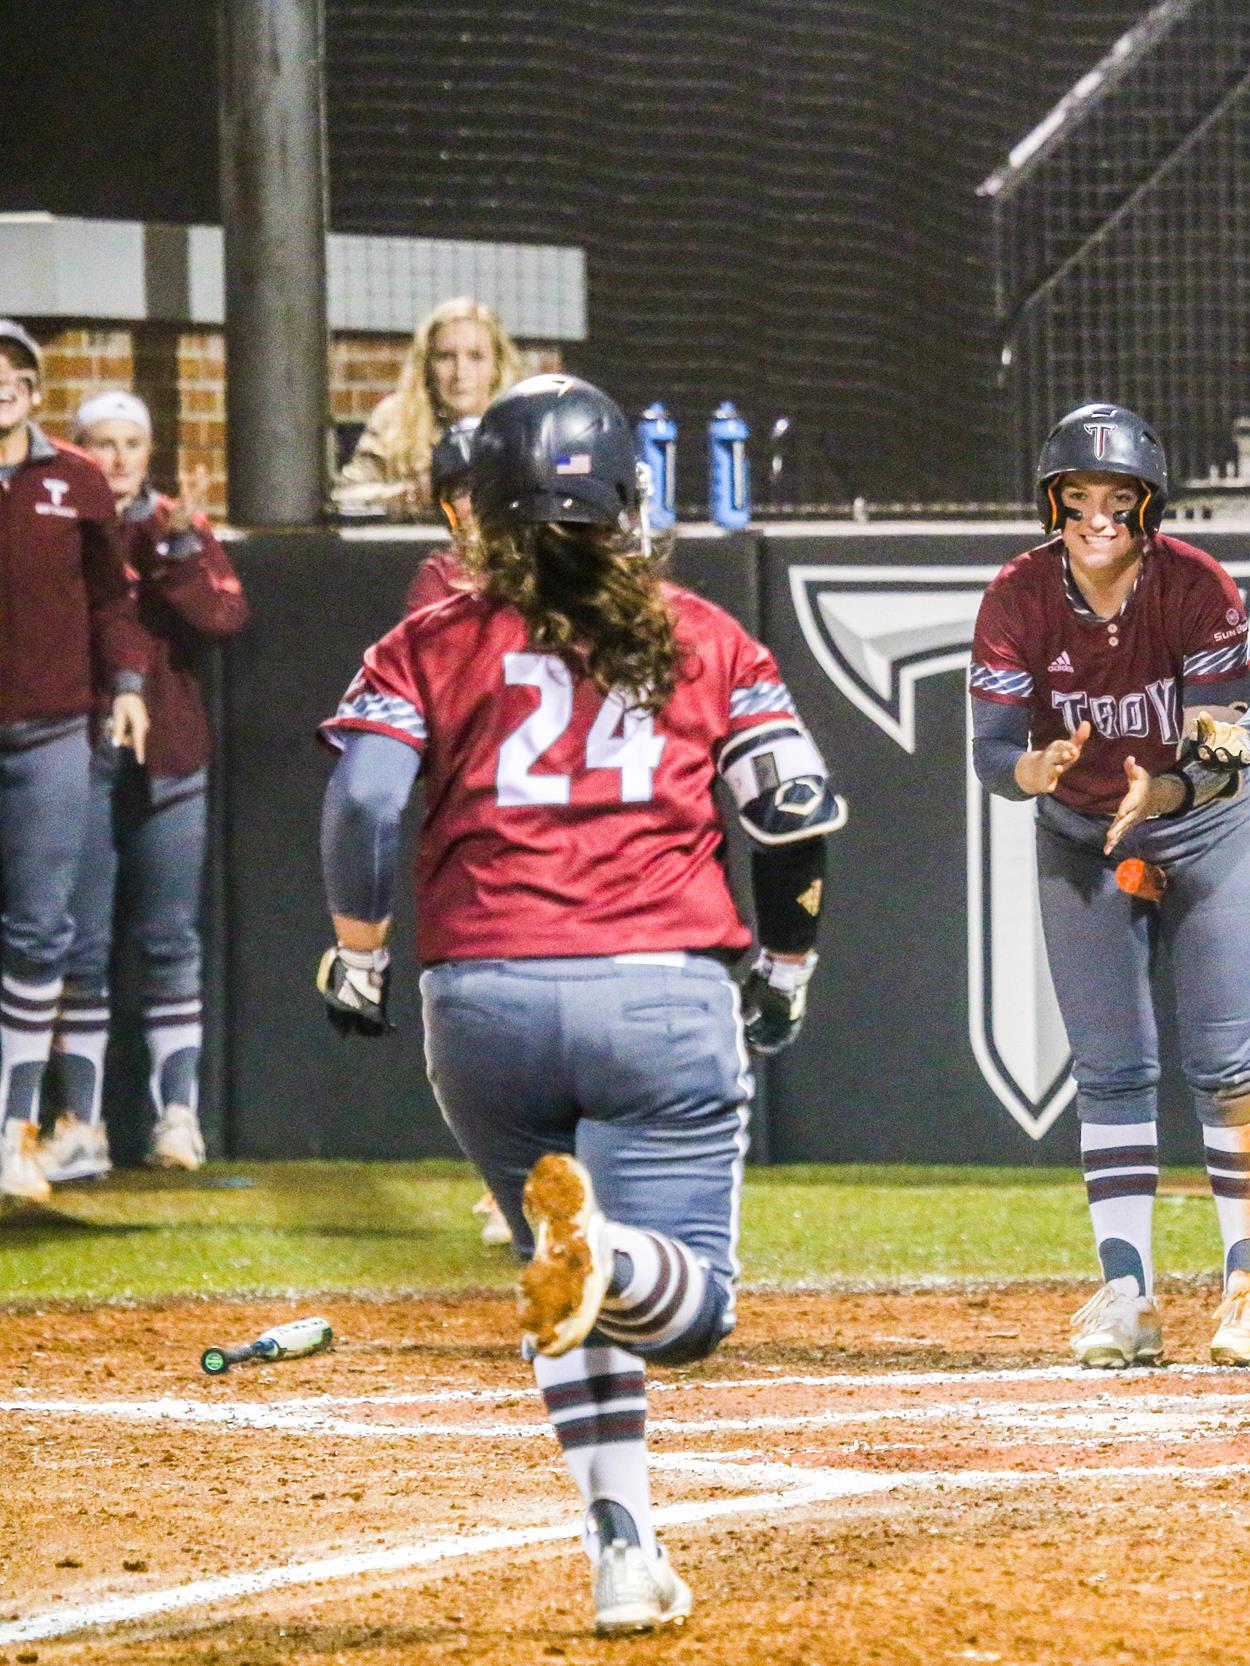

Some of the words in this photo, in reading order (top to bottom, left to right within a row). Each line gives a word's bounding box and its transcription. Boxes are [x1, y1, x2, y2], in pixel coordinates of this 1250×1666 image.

[1047, 664, 1075, 673] adidas
[496, 651, 667, 806] 24
[1051, 677, 1181, 745] TROY
